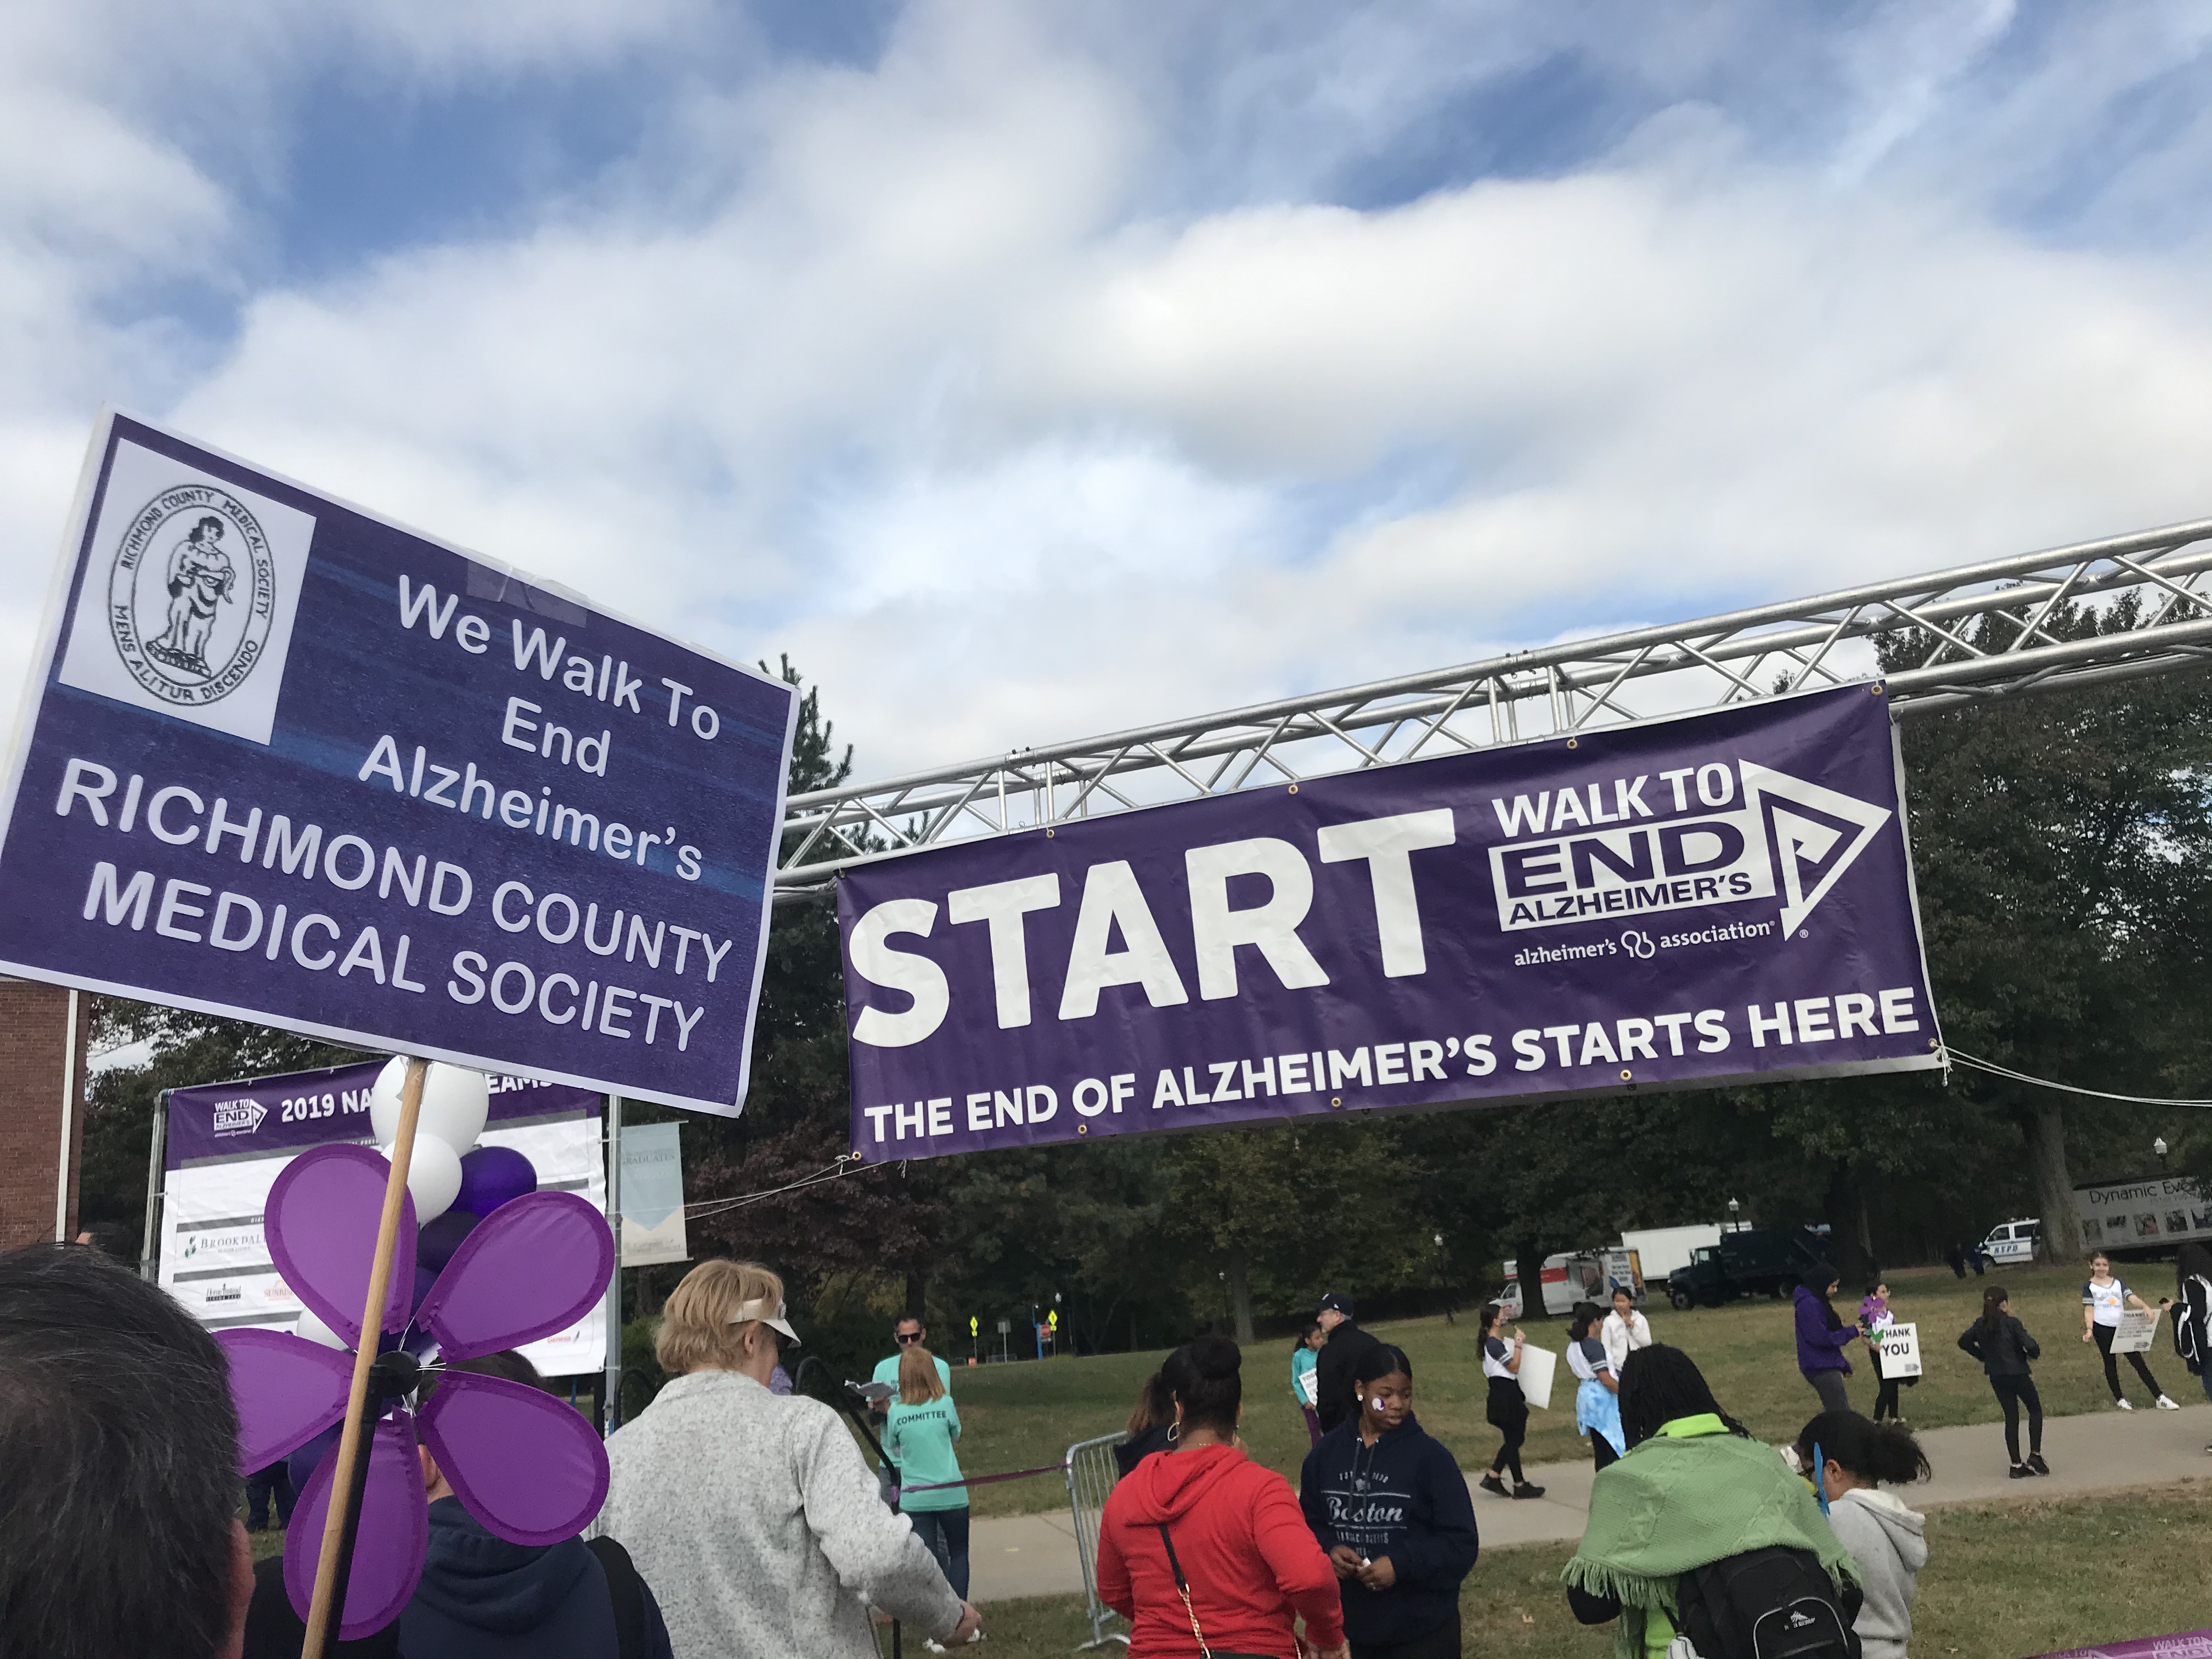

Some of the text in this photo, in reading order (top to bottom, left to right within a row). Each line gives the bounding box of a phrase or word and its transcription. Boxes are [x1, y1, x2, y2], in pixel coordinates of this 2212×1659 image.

[121, 489, 269, 620] RICHMOND COUNTY MEDICAL SOCIETY
[114, 605, 258, 701] MENS ALITUR DISCENDO
[399, 574, 720, 740] We Walk To
[501, 697, 611, 777] End
[358, 735, 702, 881] Alzheimer’s
[1491, 762, 1734, 839] WALK TO
[56, 758, 733, 983] RICHMOND COUNTY
[1500, 821, 1746, 899] END
[848, 808, 1456, 1048] START
[1508, 872, 1753, 926] ALZHEIMER’S
[83, 861, 704, 1052] MEDICAL SOCIETY
[1514, 938, 1617, 968] alzheimer’s
[864, 986, 1921, 1142] THE END OF ALZHEIMER’S STARTS HERE
[215, 1098, 250, 1112] WALK TO
[216, 1110, 250, 1124] END
[281, 1093, 335, 1123] 2019
[342, 1087, 375, 1115] NA
[2089, 1185, 2158, 1205] Dynamic
[1881, 1342, 1910, 1357] YOU
[1885, 1327, 1910, 1338] HANK
[896, 1410, 947, 1426] COMMITTEE
[1327, 1497, 1403, 1522] Boston
[2152, 1639, 2187, 1651] WALK
